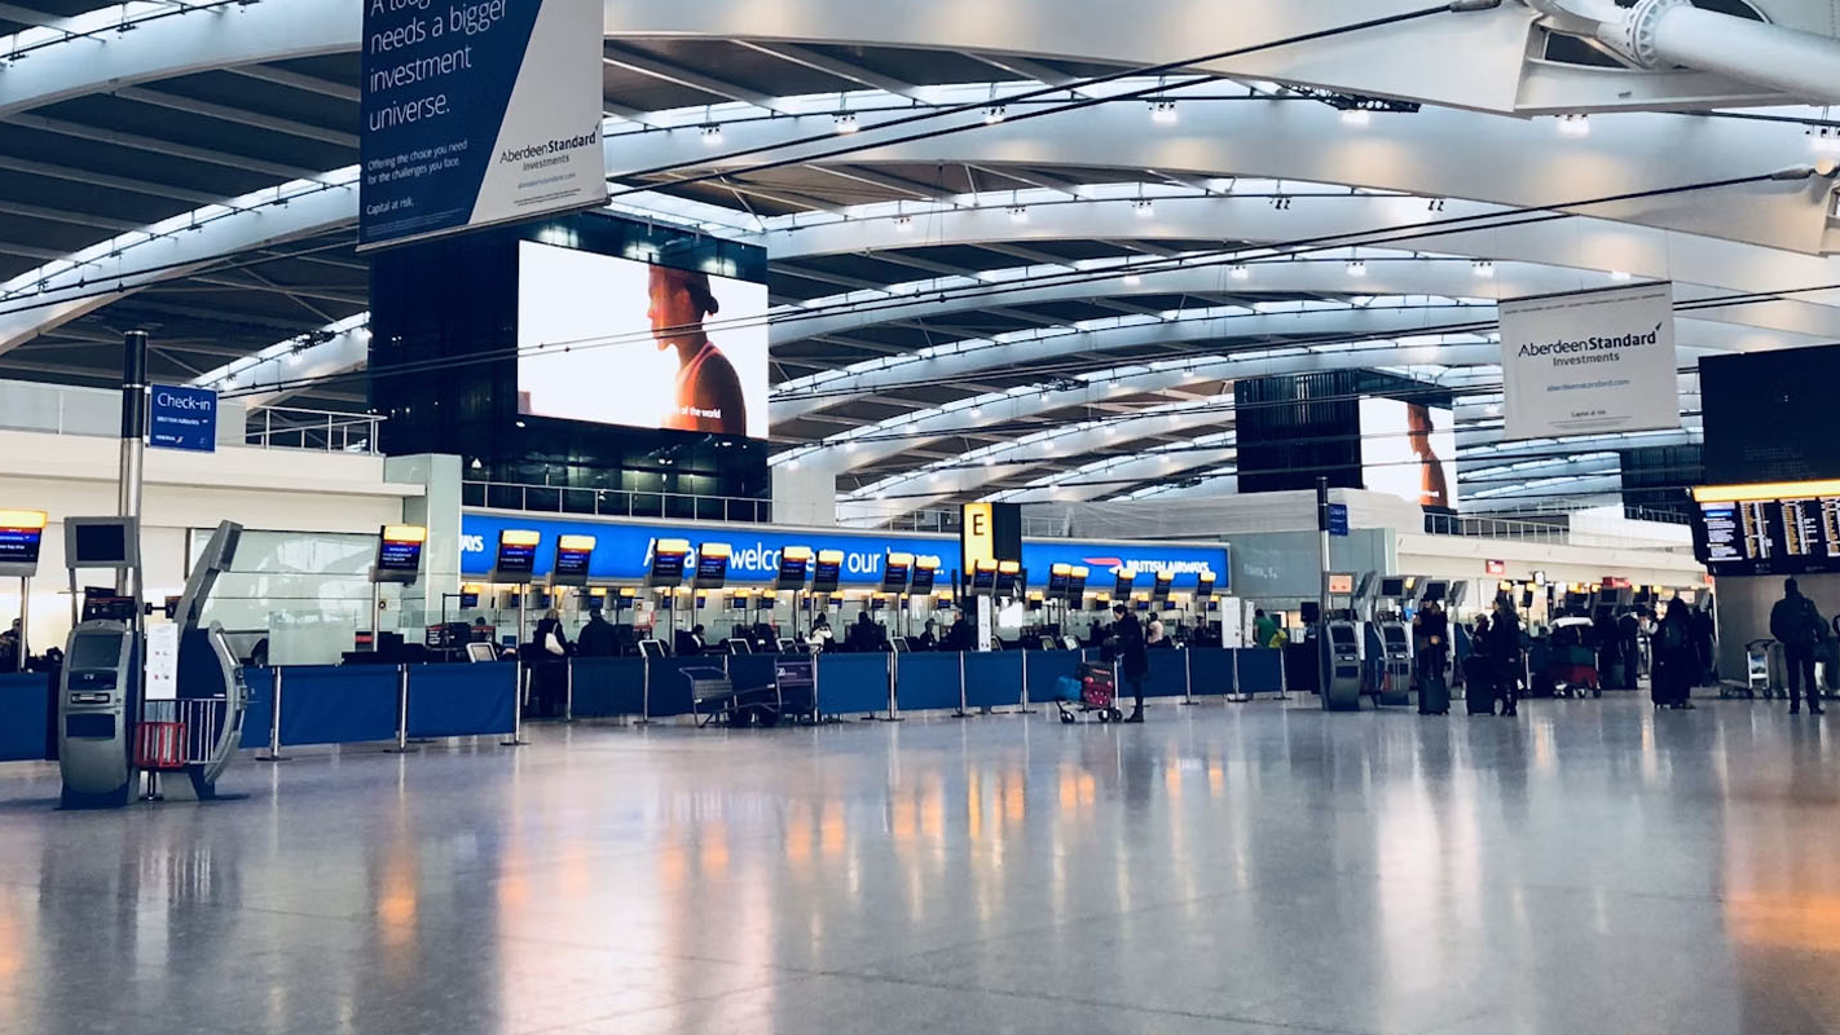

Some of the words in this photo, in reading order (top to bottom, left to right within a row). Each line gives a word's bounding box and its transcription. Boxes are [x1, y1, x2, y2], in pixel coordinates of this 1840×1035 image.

[371, 17, 426, 54] needs
[431, 16, 443, 37] a
[450, 0, 506, 35] bigger
[370, 45, 472, 93] investment
[369, 94, 450, 131] universe.
[367, 158, 397, 171] Offering
[397, 154, 409, 165] the
[410, 148, 433, 161] choice
[433, 146, 447, 158] you
[448, 139, 468, 153] need
[500, 132, 596, 164] AberdeenStandard
[367, 173, 378, 185] for
[379, 171, 391, 183] the
[391, 164, 428, 181] challenges
[428, 161, 443, 174] you
[523, 155, 569, 171] Investments
[366, 201, 390, 215] Capital
[391, 200, 399, 210] at
[1518, 331, 1657, 358] AberdeenStandard
[1553, 352, 1620, 367] Investments
[157, 392, 211, 411] Check-in
[690, 406, 701, 417] the
[973, 514, 985, 536] E
[461, 534, 484, 552] AYS
[730, 542, 816, 571] welcoe
[848, 552, 881, 573] our
